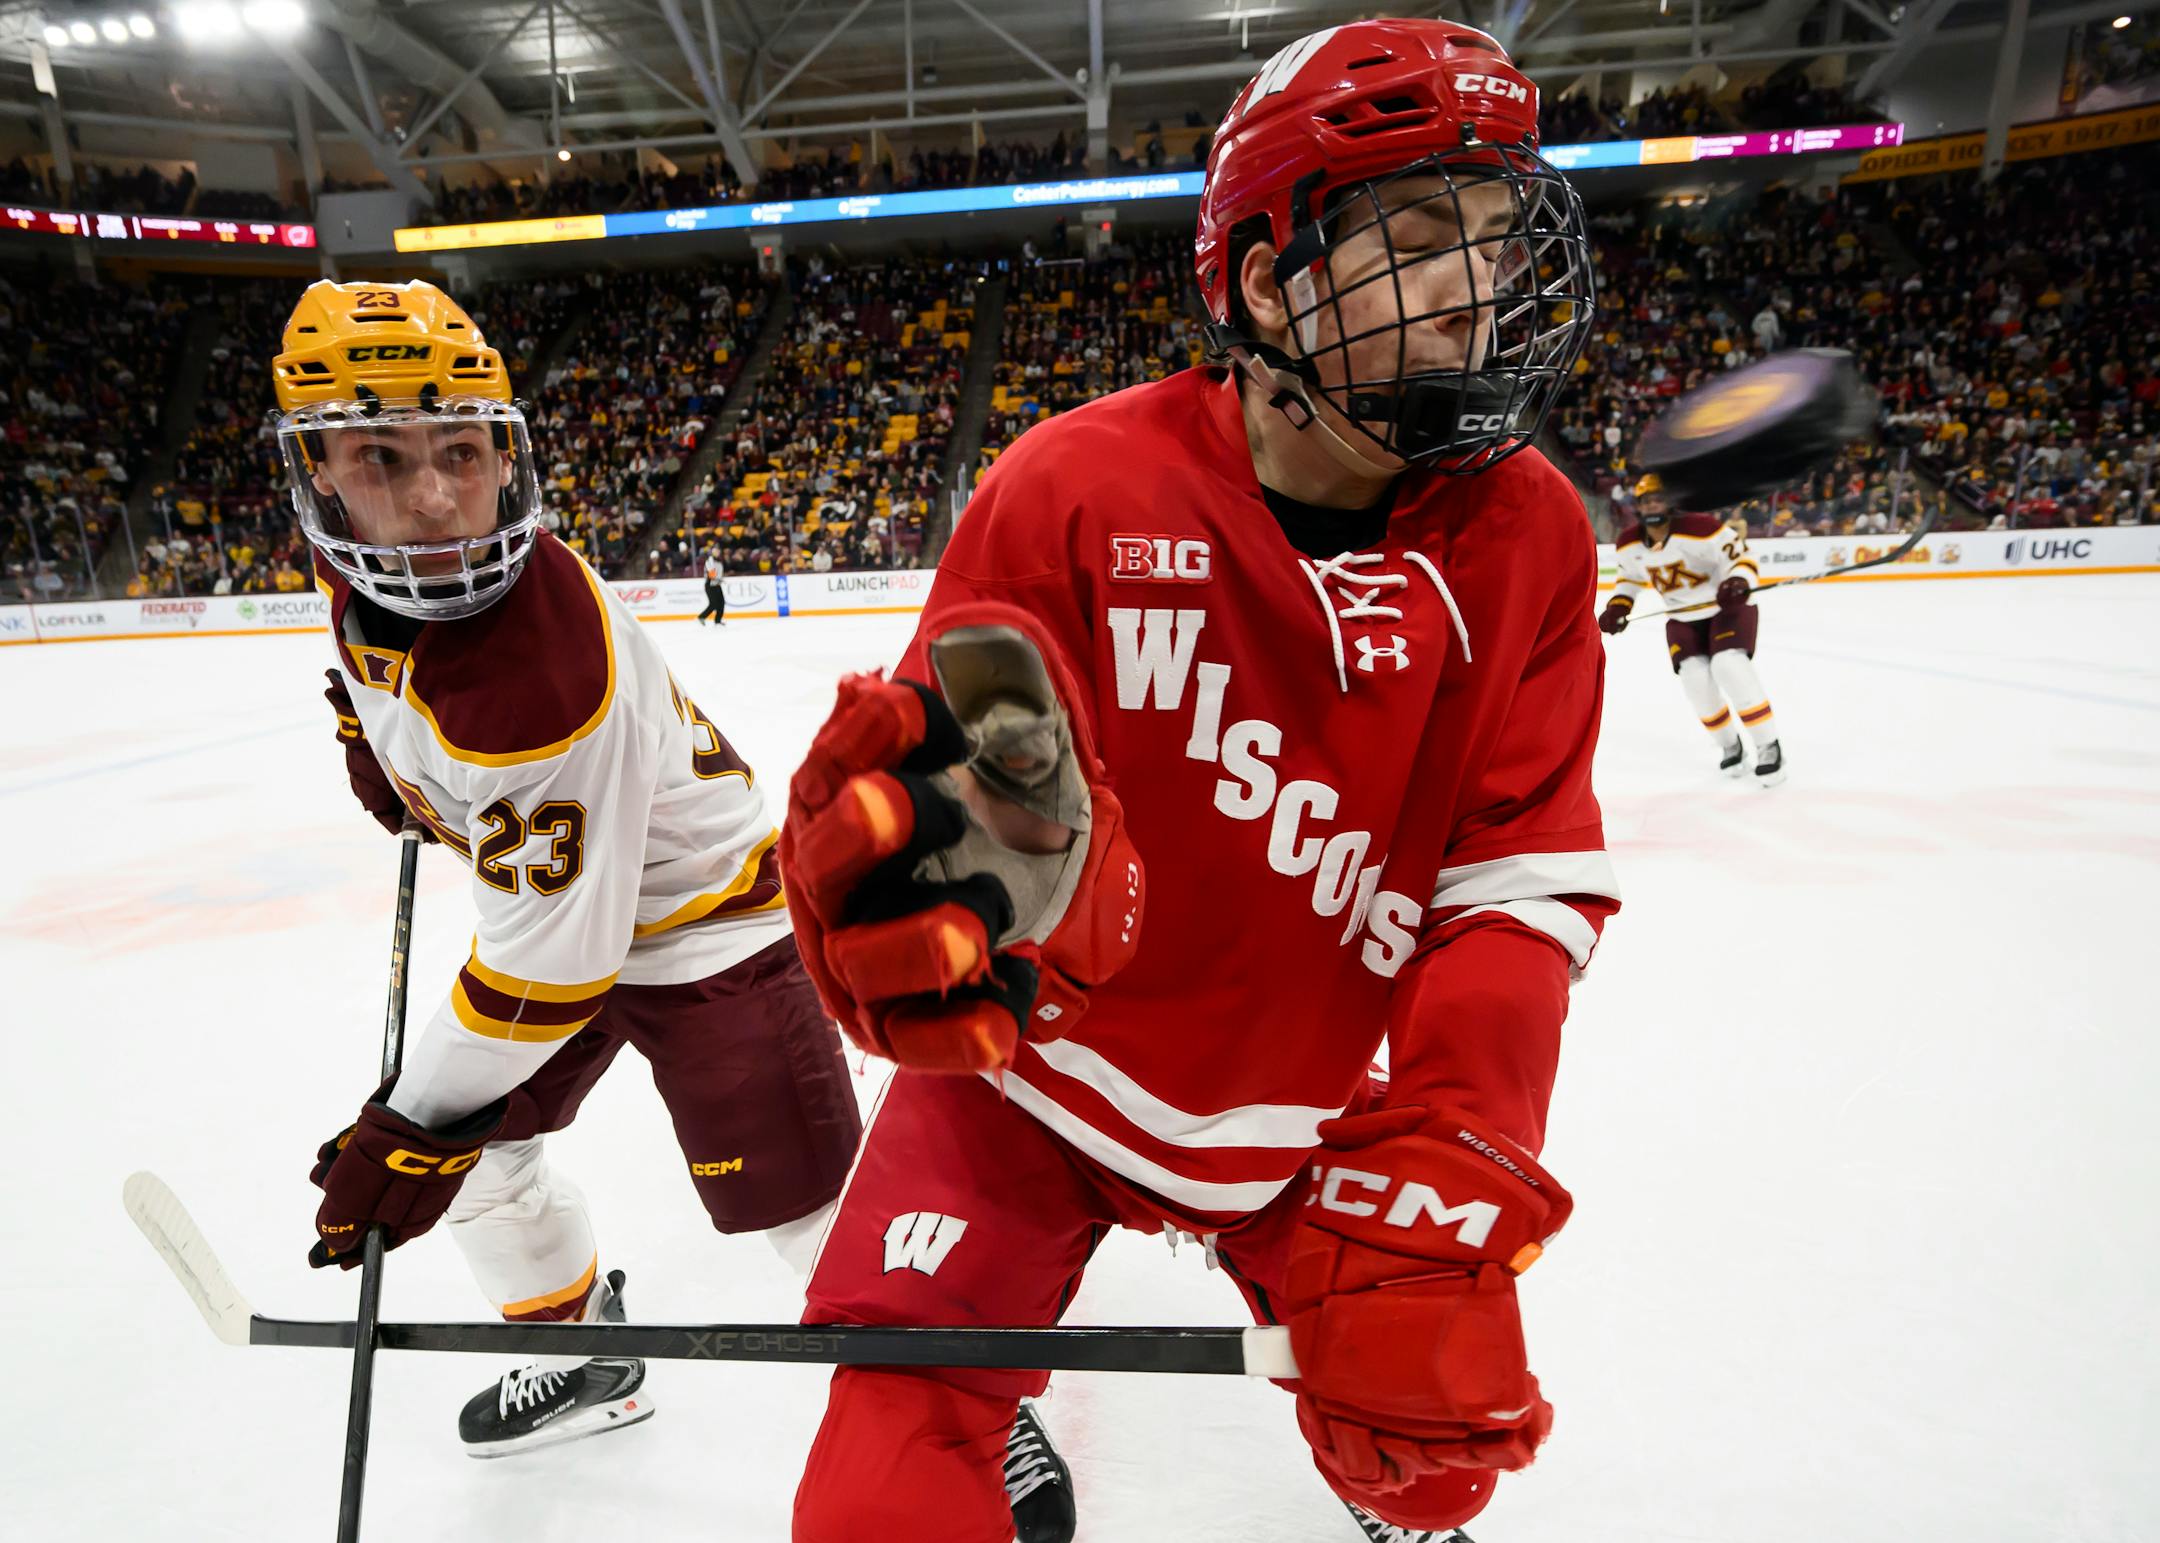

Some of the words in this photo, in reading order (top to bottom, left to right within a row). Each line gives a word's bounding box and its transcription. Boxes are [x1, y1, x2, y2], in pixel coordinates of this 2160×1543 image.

[1241, 26, 1343, 119] W
[1454, 73, 1527, 104] CCM
[1863, 148, 1940, 174] OPHER
[355, 291, 400, 308] 23
[347, 345, 431, 362] CCM
[2031, 539, 2092, 560] UHC
[39, 614, 105, 627] LOFFLER
[475, 798, 588, 897] 23
[385, 1148, 482, 1176] CC
[691, 1157, 743, 1177] CCM
[321, 1223, 354, 1234] CCM
[882, 1210, 969, 1277] W
[684, 1331, 738, 1358] XF
[741, 1331, 848, 1354] GHOST
